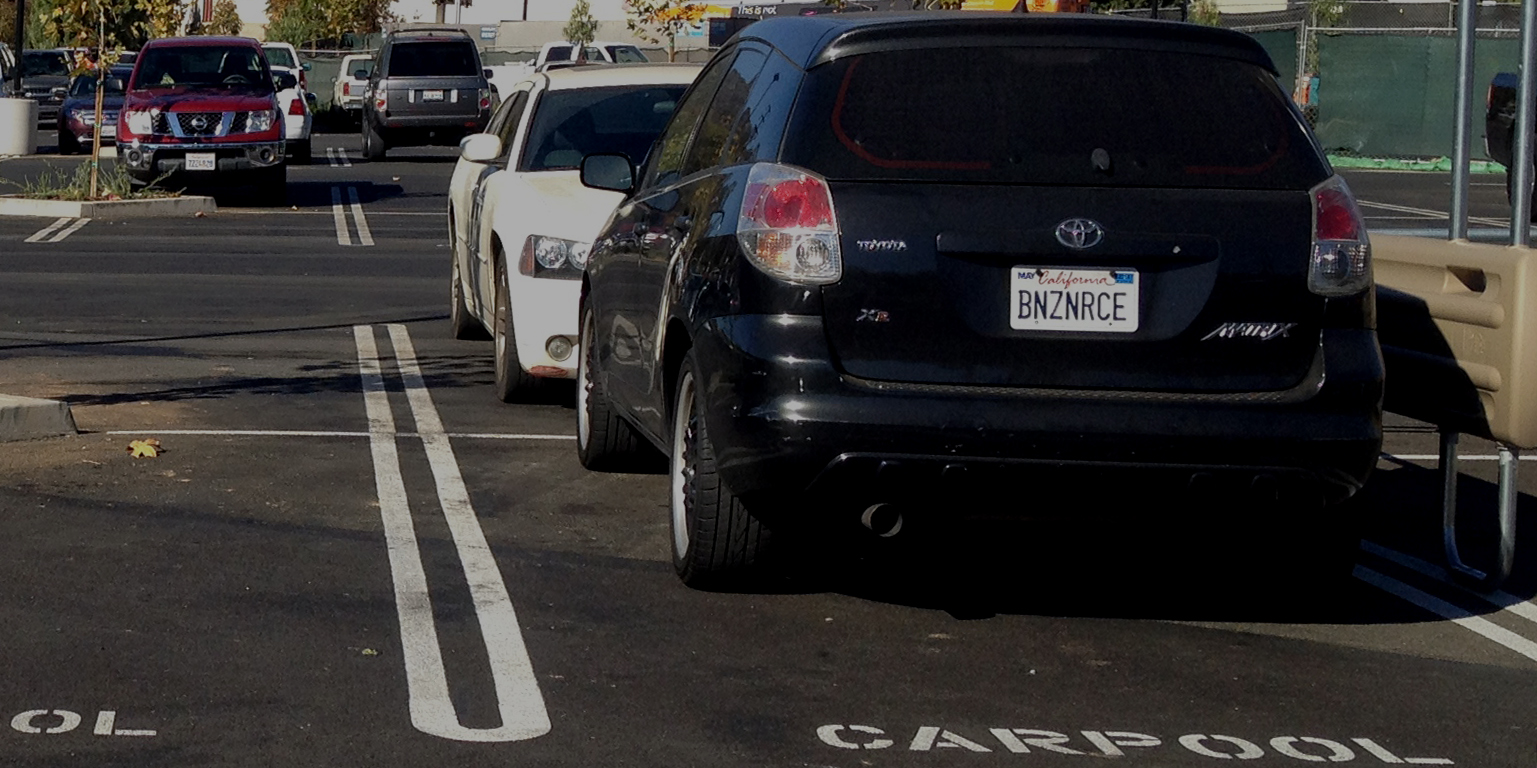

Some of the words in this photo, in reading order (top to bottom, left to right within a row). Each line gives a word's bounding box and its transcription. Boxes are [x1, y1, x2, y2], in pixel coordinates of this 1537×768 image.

[737, 5, 754, 15] This
[754, 5, 762, 15] is
[762, 5, 777, 15] not
[856, 239, 908, 252] TOYOTA
[1017, 272, 1036, 280] MAY
[1038, 270, 1116, 289] California
[1018, 289, 1127, 321] BNZNRCE
[815, 723, 1456, 765] CARPOOL
